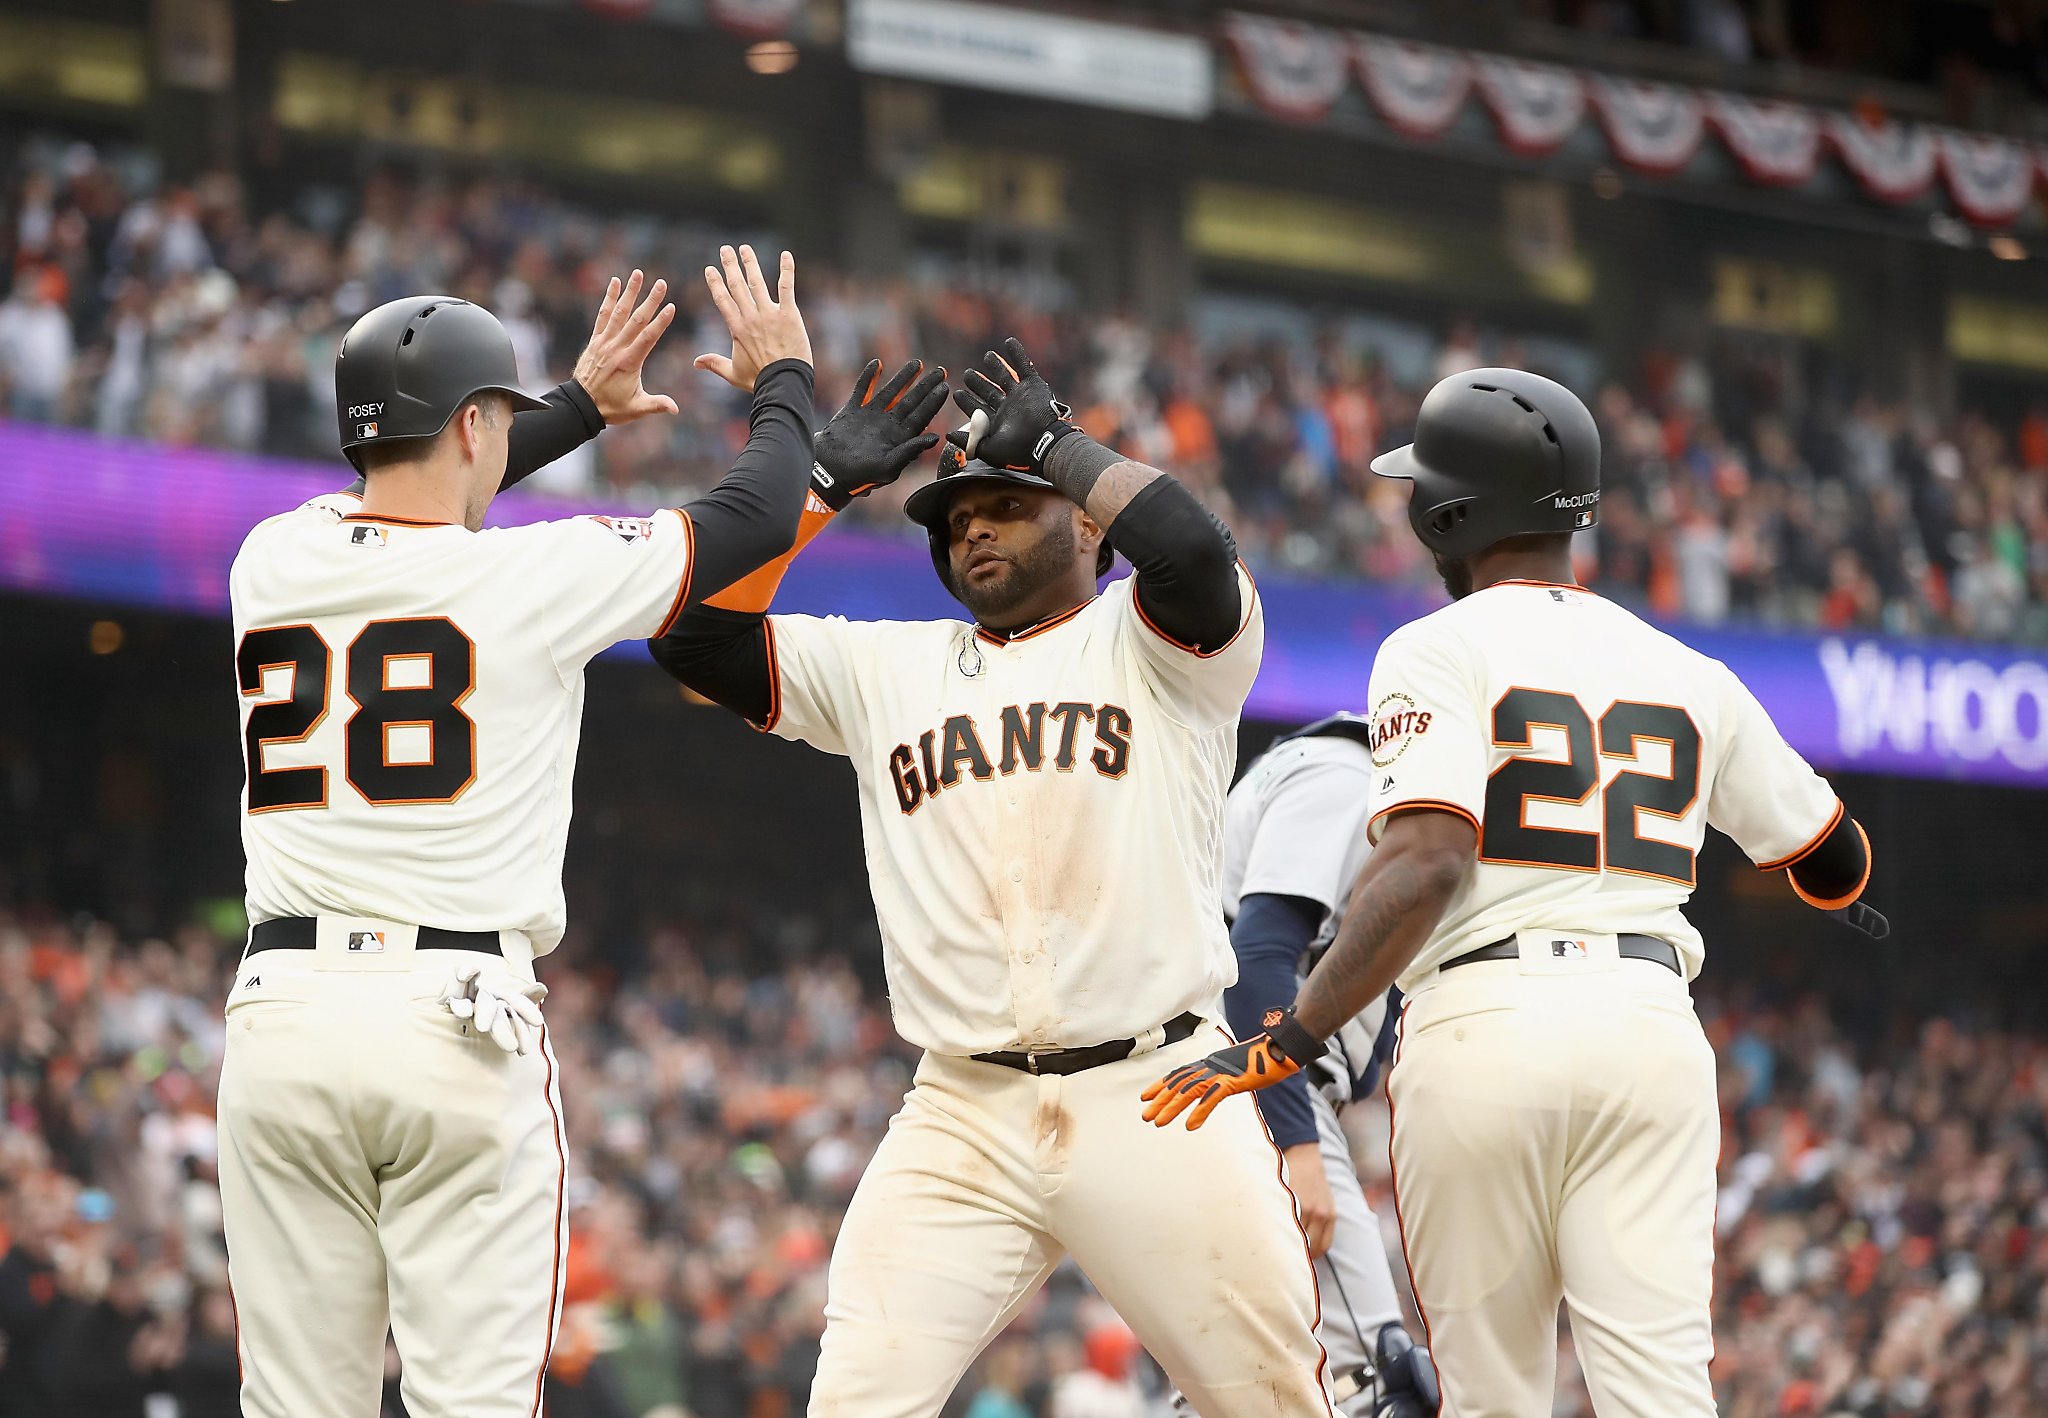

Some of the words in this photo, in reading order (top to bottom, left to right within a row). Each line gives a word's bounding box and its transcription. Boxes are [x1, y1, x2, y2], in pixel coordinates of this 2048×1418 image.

[348, 402, 385, 418] POSEY
[1554, 489, 1600, 508] McCUTCHE
[236, 616, 478, 816] 28
[889, 702, 1132, 816] GIANTS
[1371, 711, 1433, 753] IANTS
[1818, 636, 2048, 772] YAHOO
[1478, 685, 1703, 890] 22
